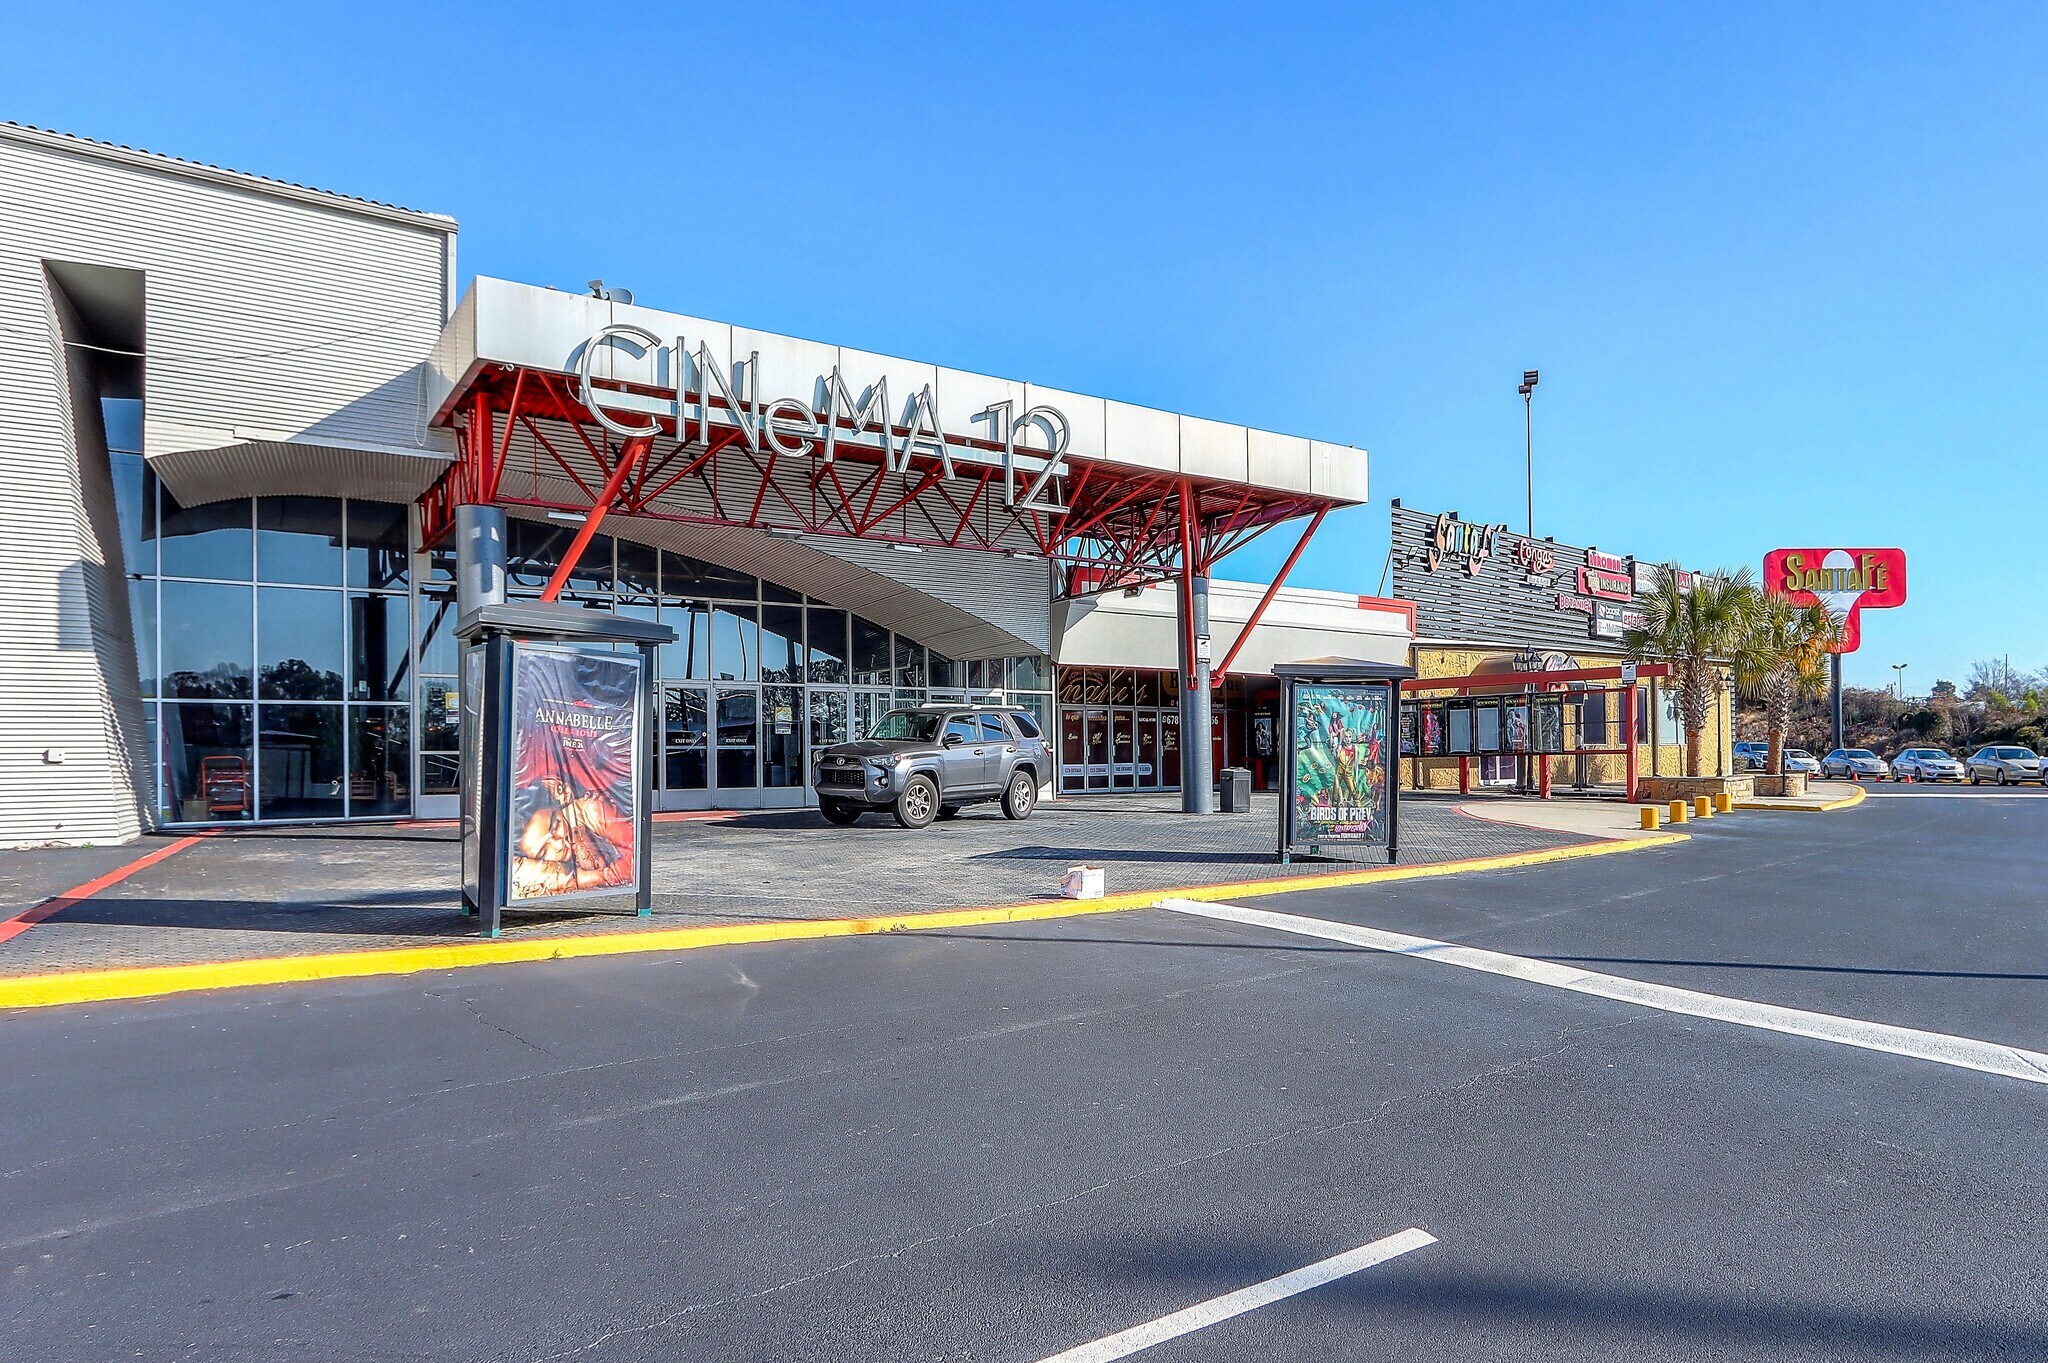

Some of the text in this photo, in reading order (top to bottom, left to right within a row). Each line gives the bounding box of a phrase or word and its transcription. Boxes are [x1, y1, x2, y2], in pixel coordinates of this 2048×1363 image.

[986, 400, 1070, 514] 12
[1519, 538, 1556, 574] Congas
[1600, 577, 1631, 594] INSURANCE
[1559, 592, 1593, 614] BOTANICA
[1605, 605, 1621, 616] boost
[535, 706, 613, 730] ANNABELLE
[1310, 806, 1337, 821] BIRDS
[1338, 807, 1349, 821] OF
